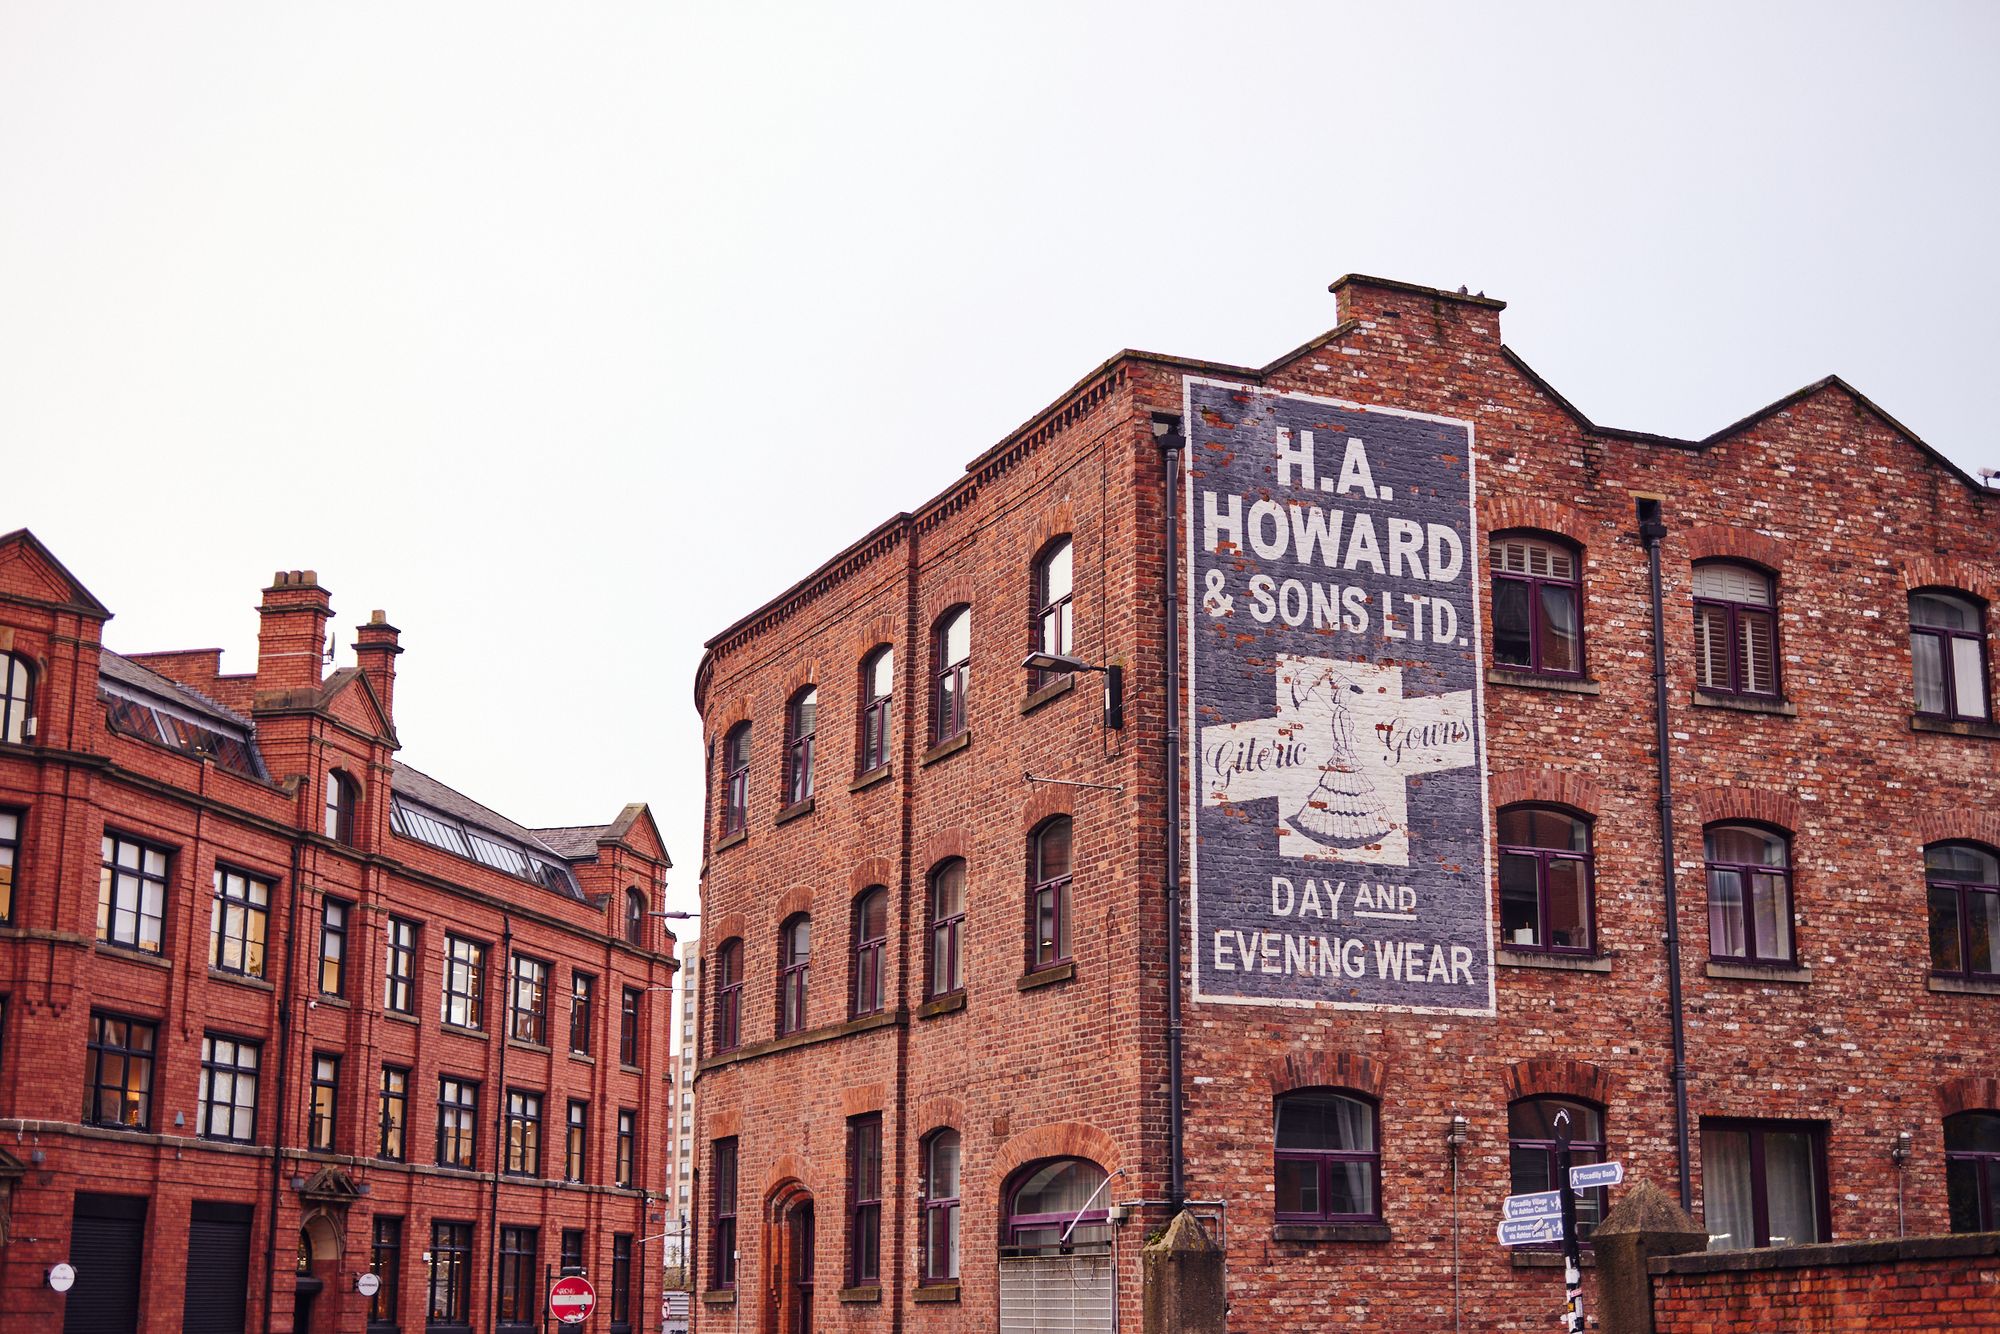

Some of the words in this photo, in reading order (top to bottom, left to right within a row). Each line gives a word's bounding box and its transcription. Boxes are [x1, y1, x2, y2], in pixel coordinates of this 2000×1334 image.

[1203, 491, 1464, 583] HOWARD
[1203, 568, 1234, 617] &
[1249, 574, 1371, 634] SONS
[1383, 591, 1469, 647] LTD.
[1205, 736, 1308, 792] Gileric
[1376, 716, 1470, 768] Gowns
[1271, 876, 1346, 920] DAY
[1354, 883, 1417, 913] AND
[1213, 929, 1366, 979] EVENING
[1373, 939, 1475, 986] WEAR
[1580, 1171, 1601, 1180] Piccadilly
[1602, 1169, 1616, 1177] Basin
[1511, 1199, 1531, 1208] Piccadilly
[1531, 1198, 1548, 1206] Village
[1504, 1225, 1517, 1233] Great
